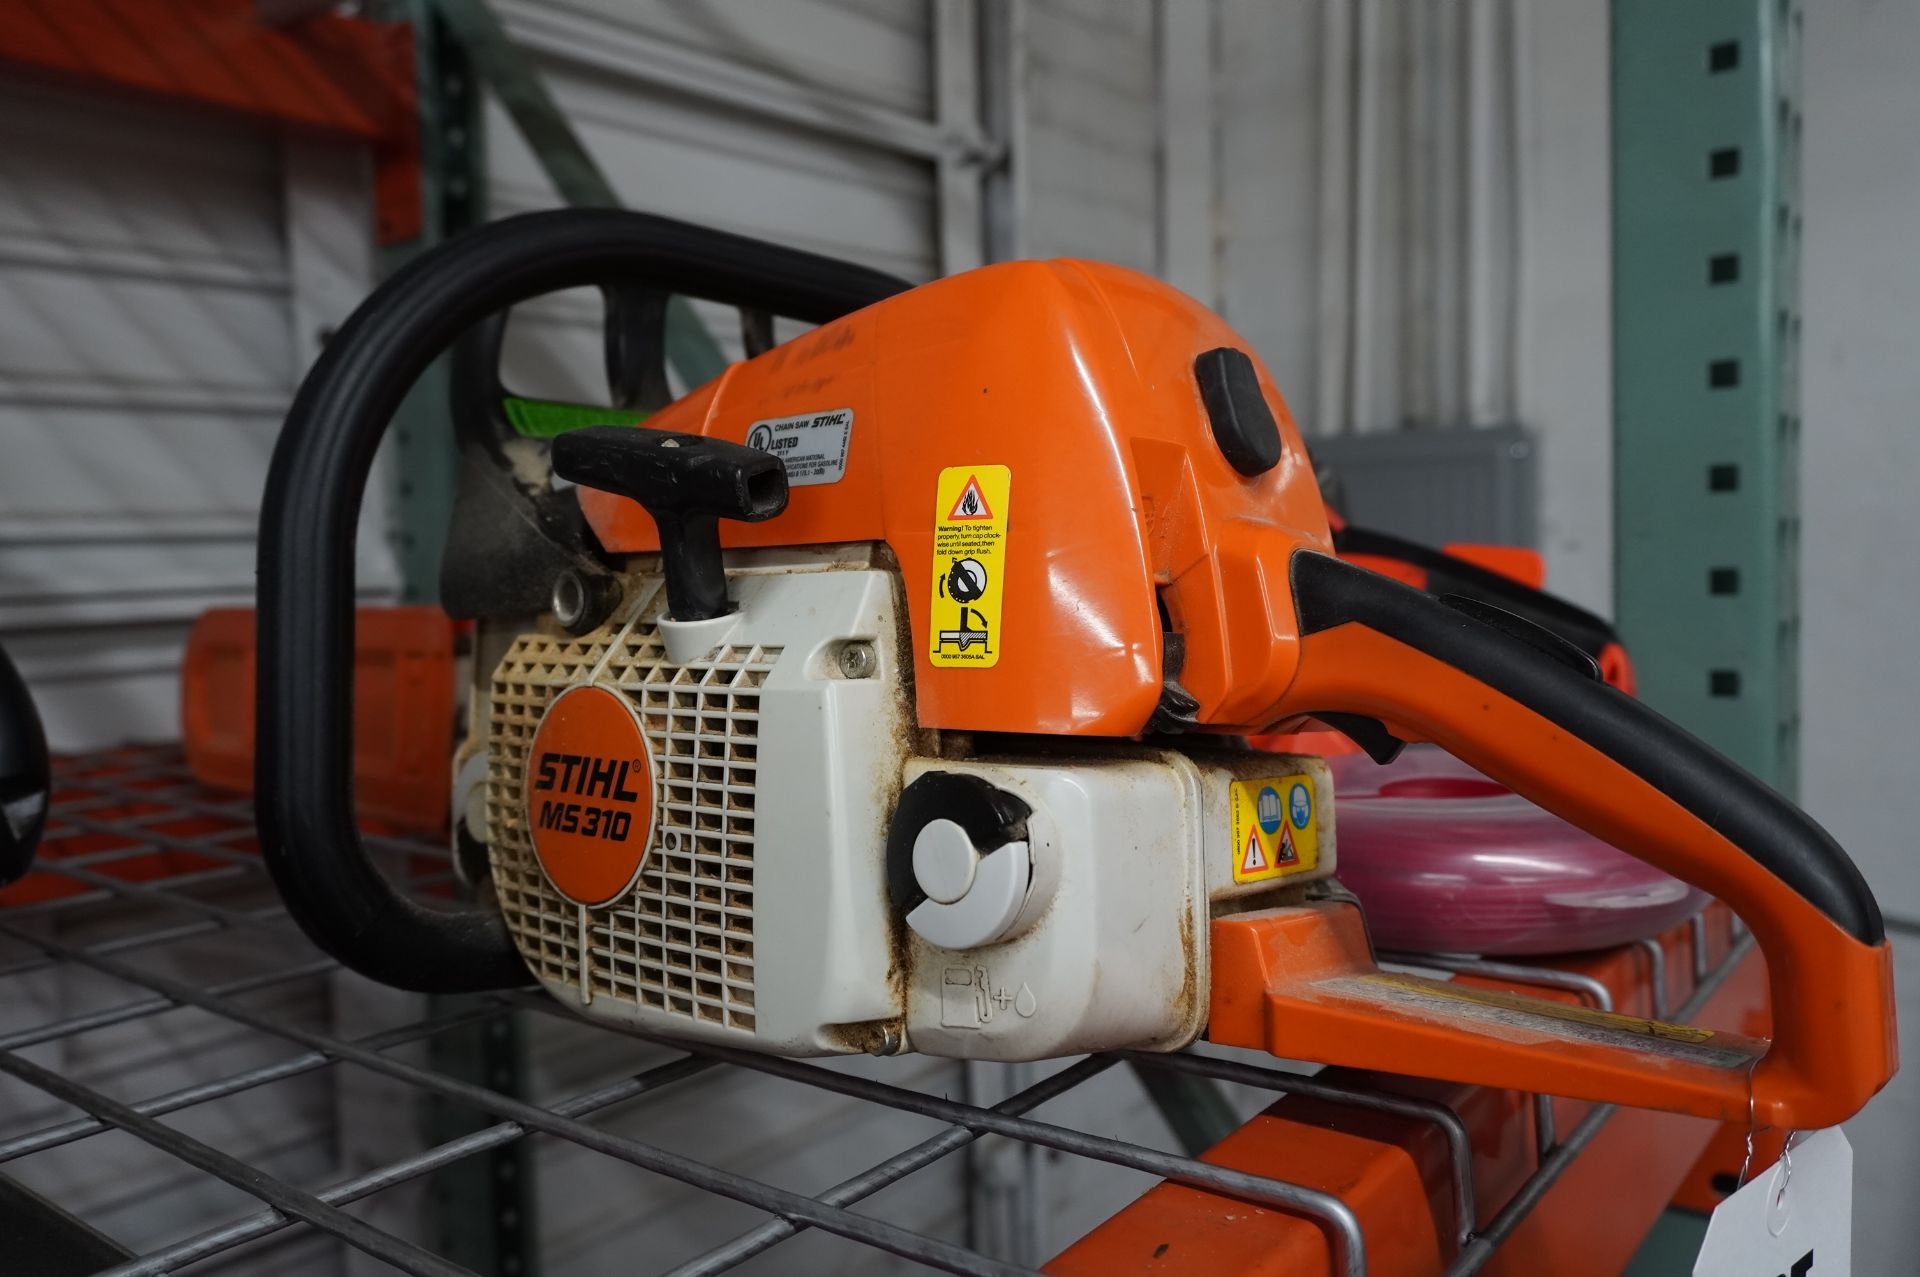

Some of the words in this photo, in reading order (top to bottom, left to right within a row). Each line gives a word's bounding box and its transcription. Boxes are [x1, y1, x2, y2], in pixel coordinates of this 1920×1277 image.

[775, 422, 795, 432] CHAIN
[795, 420, 810, 429] SAW
[753, 431, 764, 451] UL
[771, 437, 799, 450] LISTED
[818, 459, 838, 467] GASOLINE
[964, 548, 975, 556] grip
